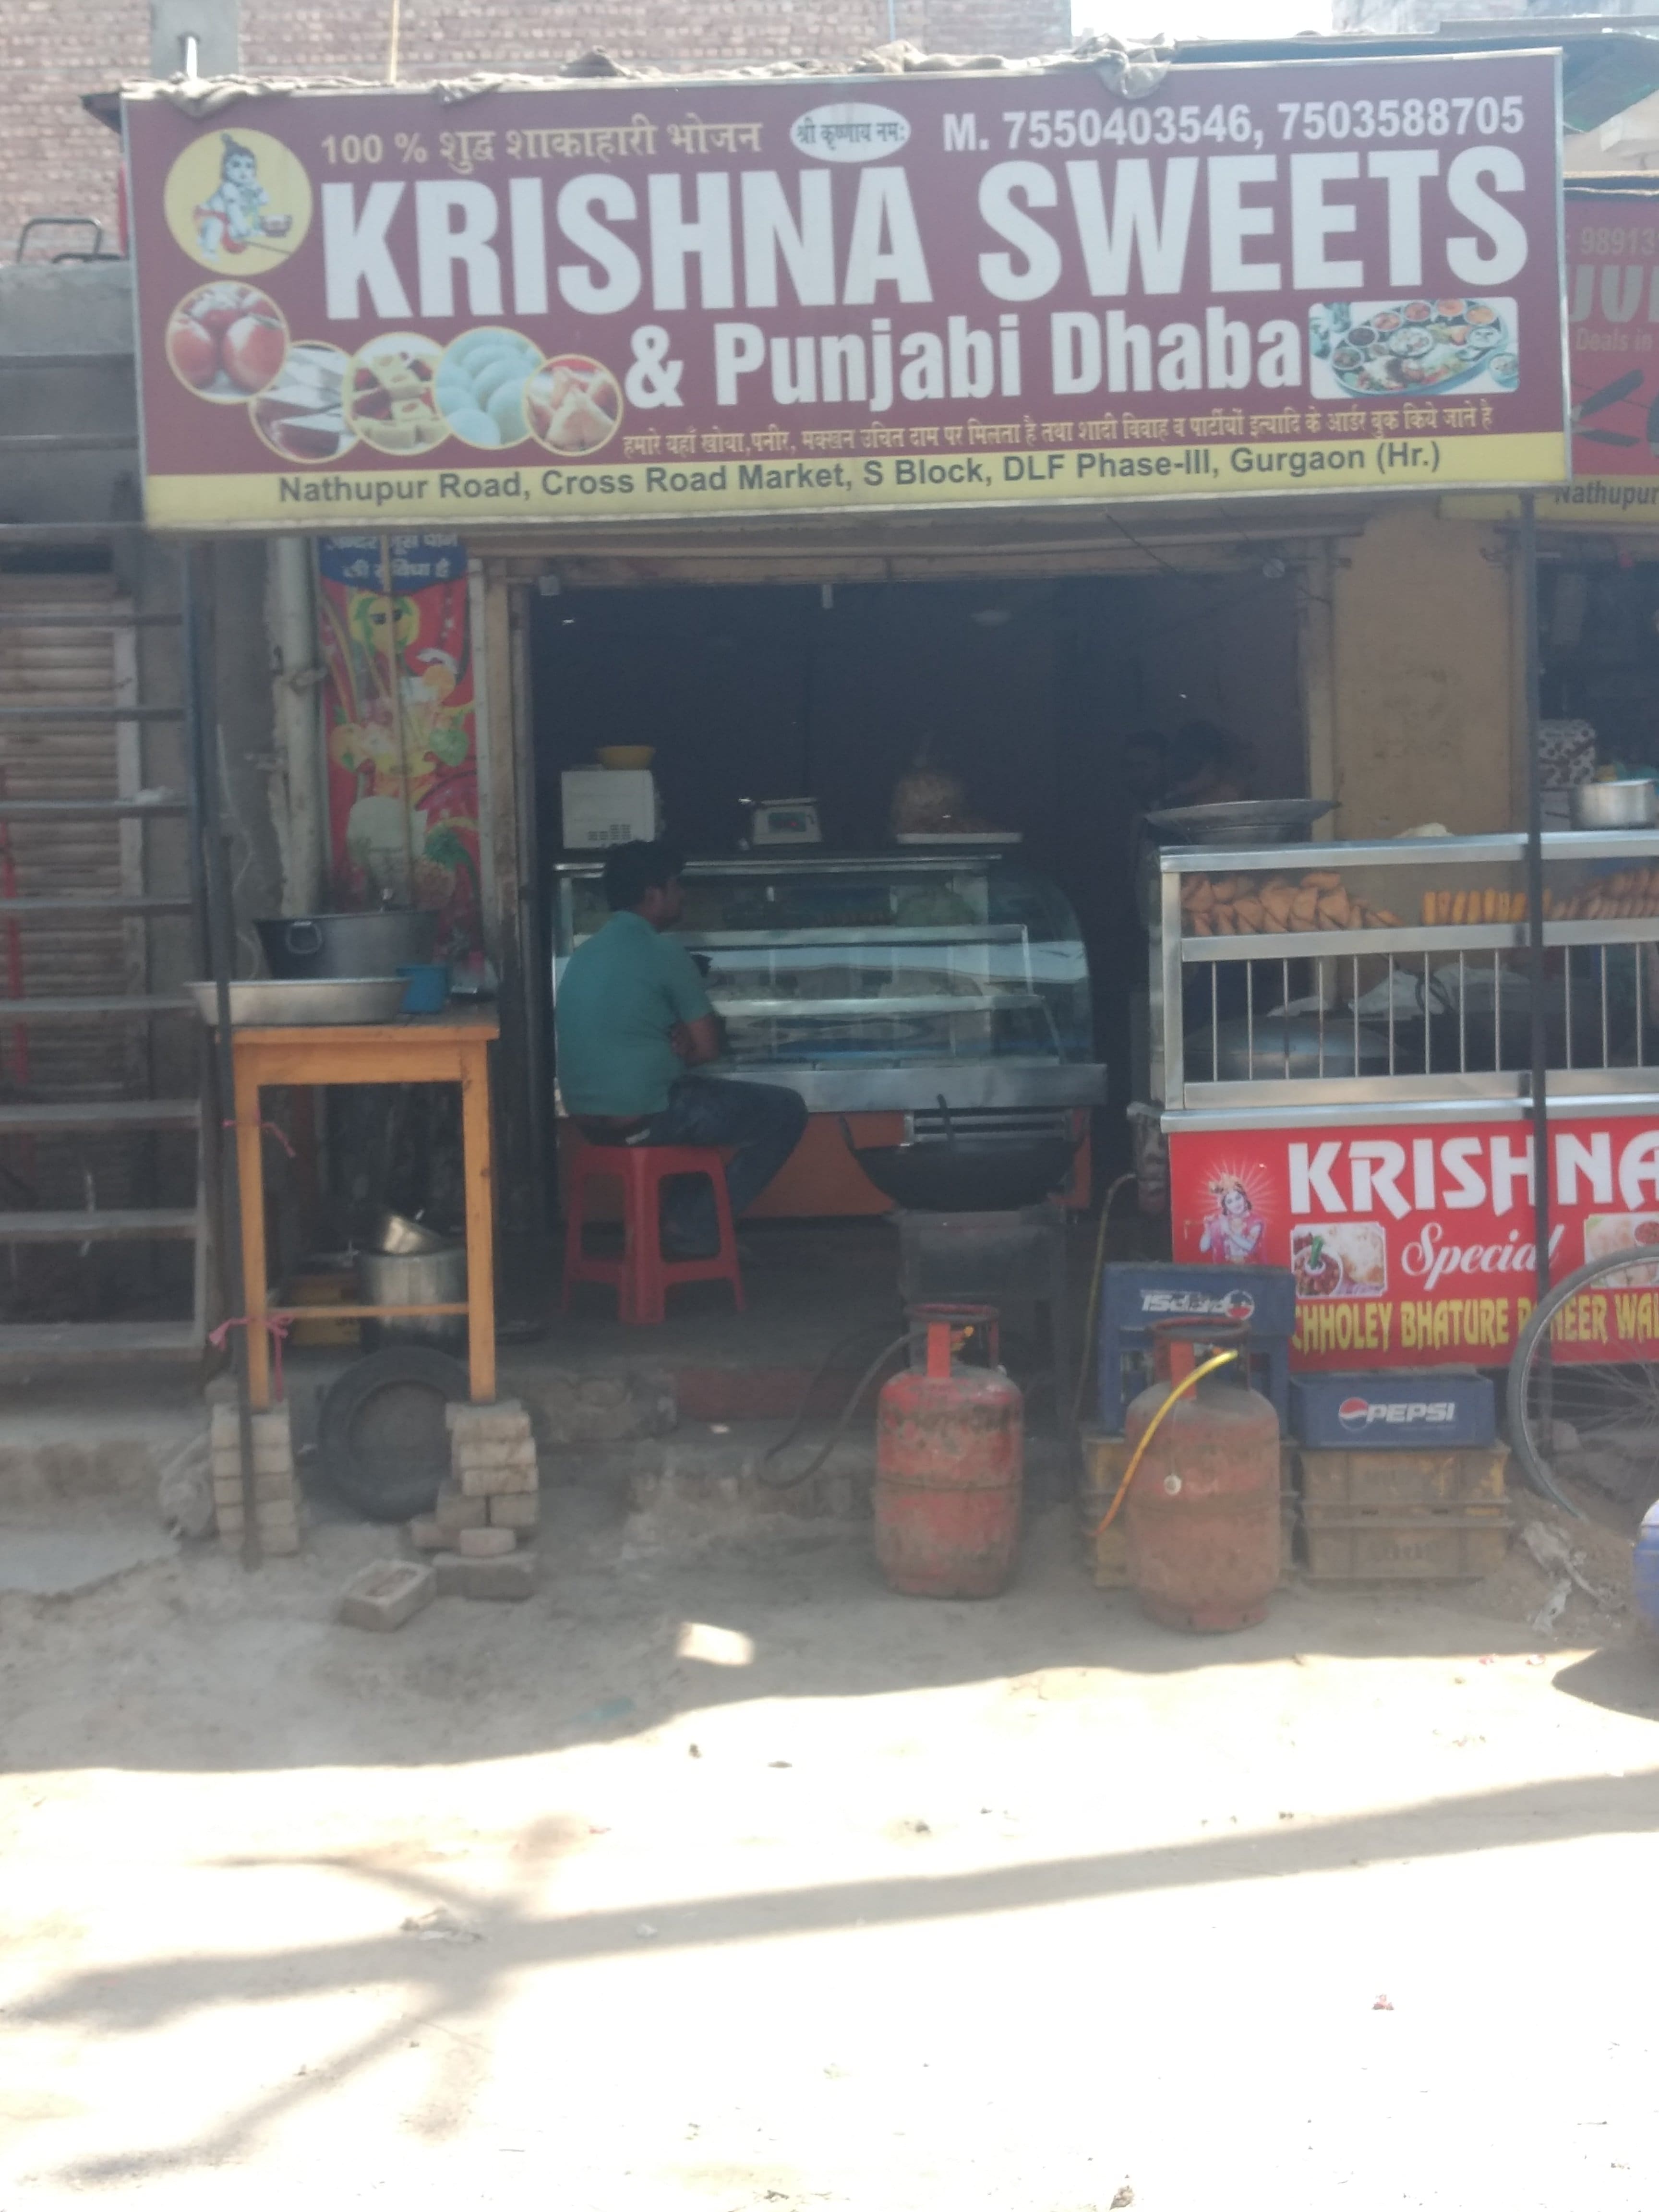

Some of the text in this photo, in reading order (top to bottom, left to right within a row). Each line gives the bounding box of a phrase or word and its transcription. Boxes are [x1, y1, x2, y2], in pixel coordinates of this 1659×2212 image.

[321, 133, 384, 165] 100
[394, 132, 429, 164] %
[505, 112, 659, 163] शाकाहारी
[667, 112, 763, 154] भोजन
[796, 118, 816, 144] श्री
[943, 96, 1524, 151] M. 7550403546, 7503588705
[322, 145, 1529, 320] KRISHNA SWEETS
[625, 306, 1302, 412] & Punjabi Dhaba
[1576, 326, 1629, 352] Deals
[623, 427, 662, 458] हमारे
[860, 421, 905, 449] उचित
[909, 426, 940, 447] दाम
[944, 425, 963, 446] पर
[967, 417, 1021, 446] मिलता
[1041, 421, 1074, 442] तथा
[1078, 412, 1118, 441] शादी
[1122, 411, 1169, 442] विवाह
[1173, 418, 1185, 438] व
[1249, 407, 1301, 437] इत्यादि
[1304, 407, 1321, 433] के
[1370, 410, 1398, 439] बुक
[1402, 402, 1439, 430] किये
[1442, 401, 1477, 429] जाते
[279, 477, 428, 505] Nathupur
[439, 471, 530, 501] Road,
[541, 469, 635, 496] Cross
[646, 466, 727, 493] Road
[738, 463, 853, 491] Market,
[864, 460, 884, 486] S
[895, 457, 992, 487] Block,
[1004, 454, 1065, 482] DLF
[1230, 446, 1365, 478] Gurgaon
[1376, 441, 1441, 474] (Hr.)
[1402, 1222, 1565, 1291] Special
[1400, 1298, 1509, 1351] BHATURE
[1517, 1295, 1608, 1345] PNEER
[1366, 1401, 1455, 1424] PEPSI
